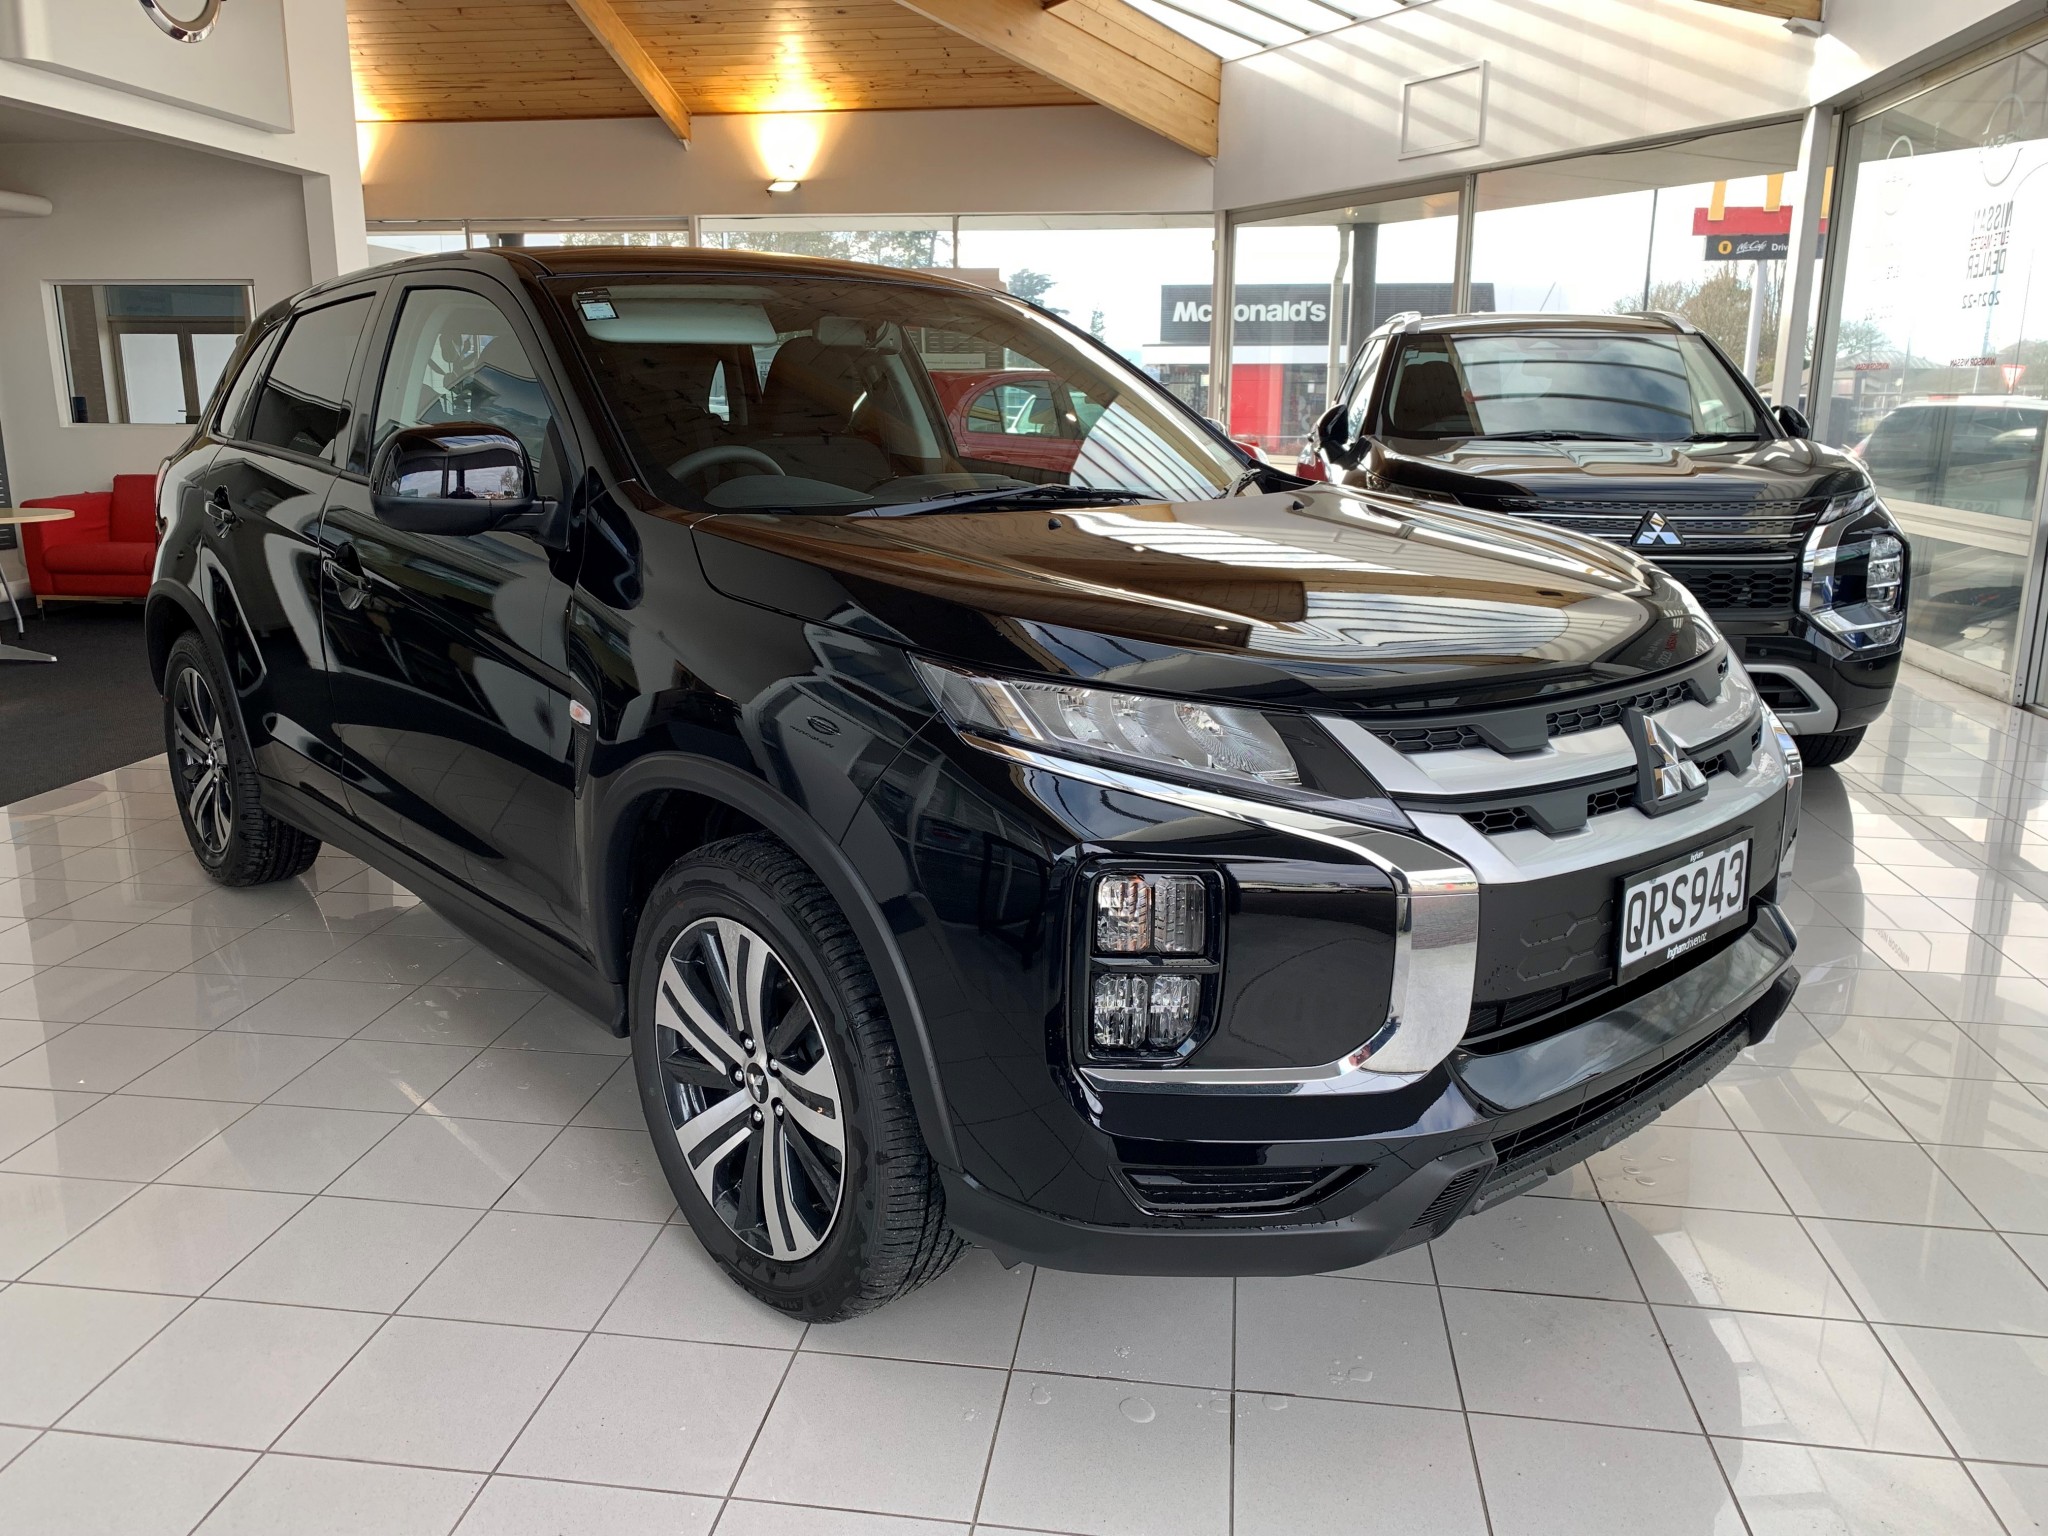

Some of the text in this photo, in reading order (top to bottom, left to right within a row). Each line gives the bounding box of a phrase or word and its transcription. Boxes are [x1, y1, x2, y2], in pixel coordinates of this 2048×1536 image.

[1771, 243, 1789, 251] Driv
[1172, 300, 1327, 323] Mconald's
[1625, 850, 1744, 953] QRS943
